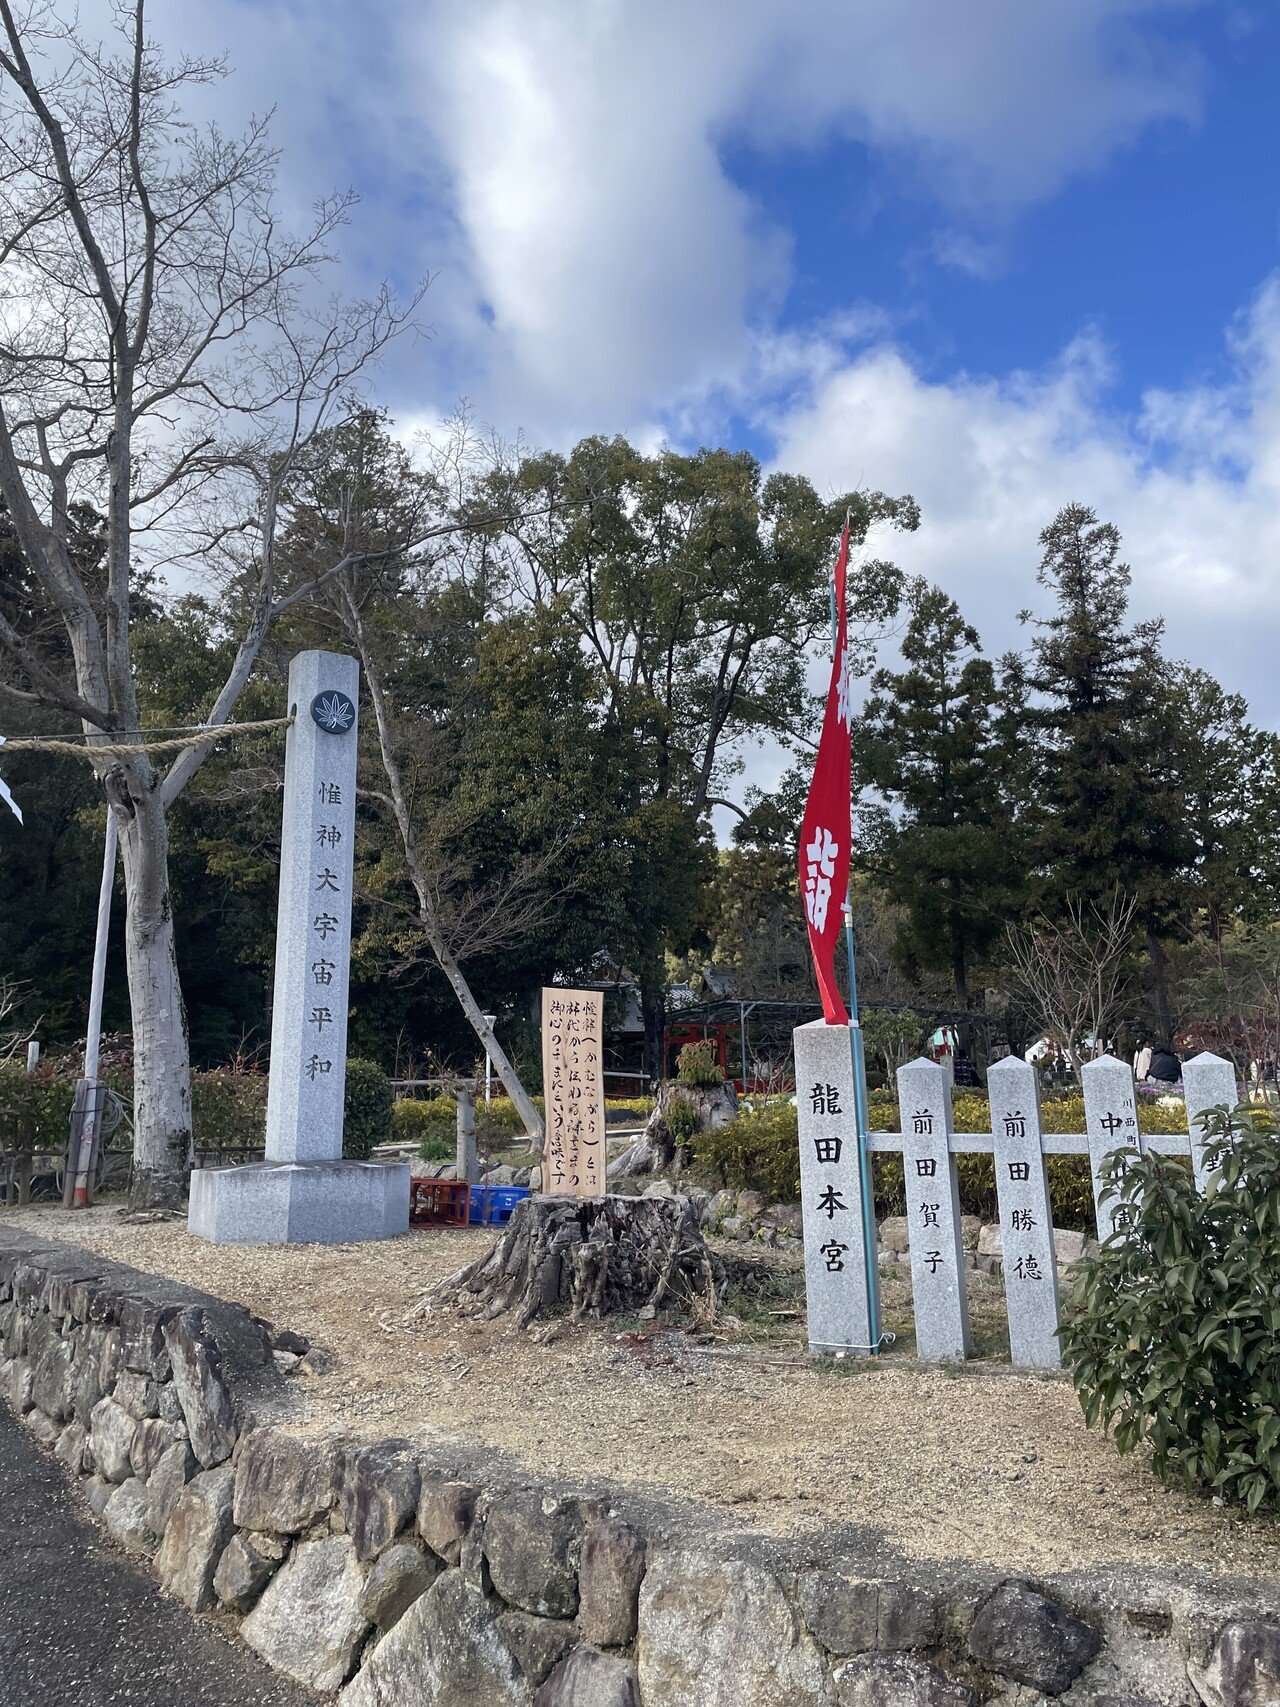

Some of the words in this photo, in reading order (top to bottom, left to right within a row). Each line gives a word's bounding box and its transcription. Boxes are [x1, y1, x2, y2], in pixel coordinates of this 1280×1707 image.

[304, 781, 342, 1082] 惟神大宇宙平和
[809, 1082, 849, 1273] 龍田本宮
[911, 1108, 944, 1274] 前田賀子
[1122, 1098, 1136, 1146] 川西町
